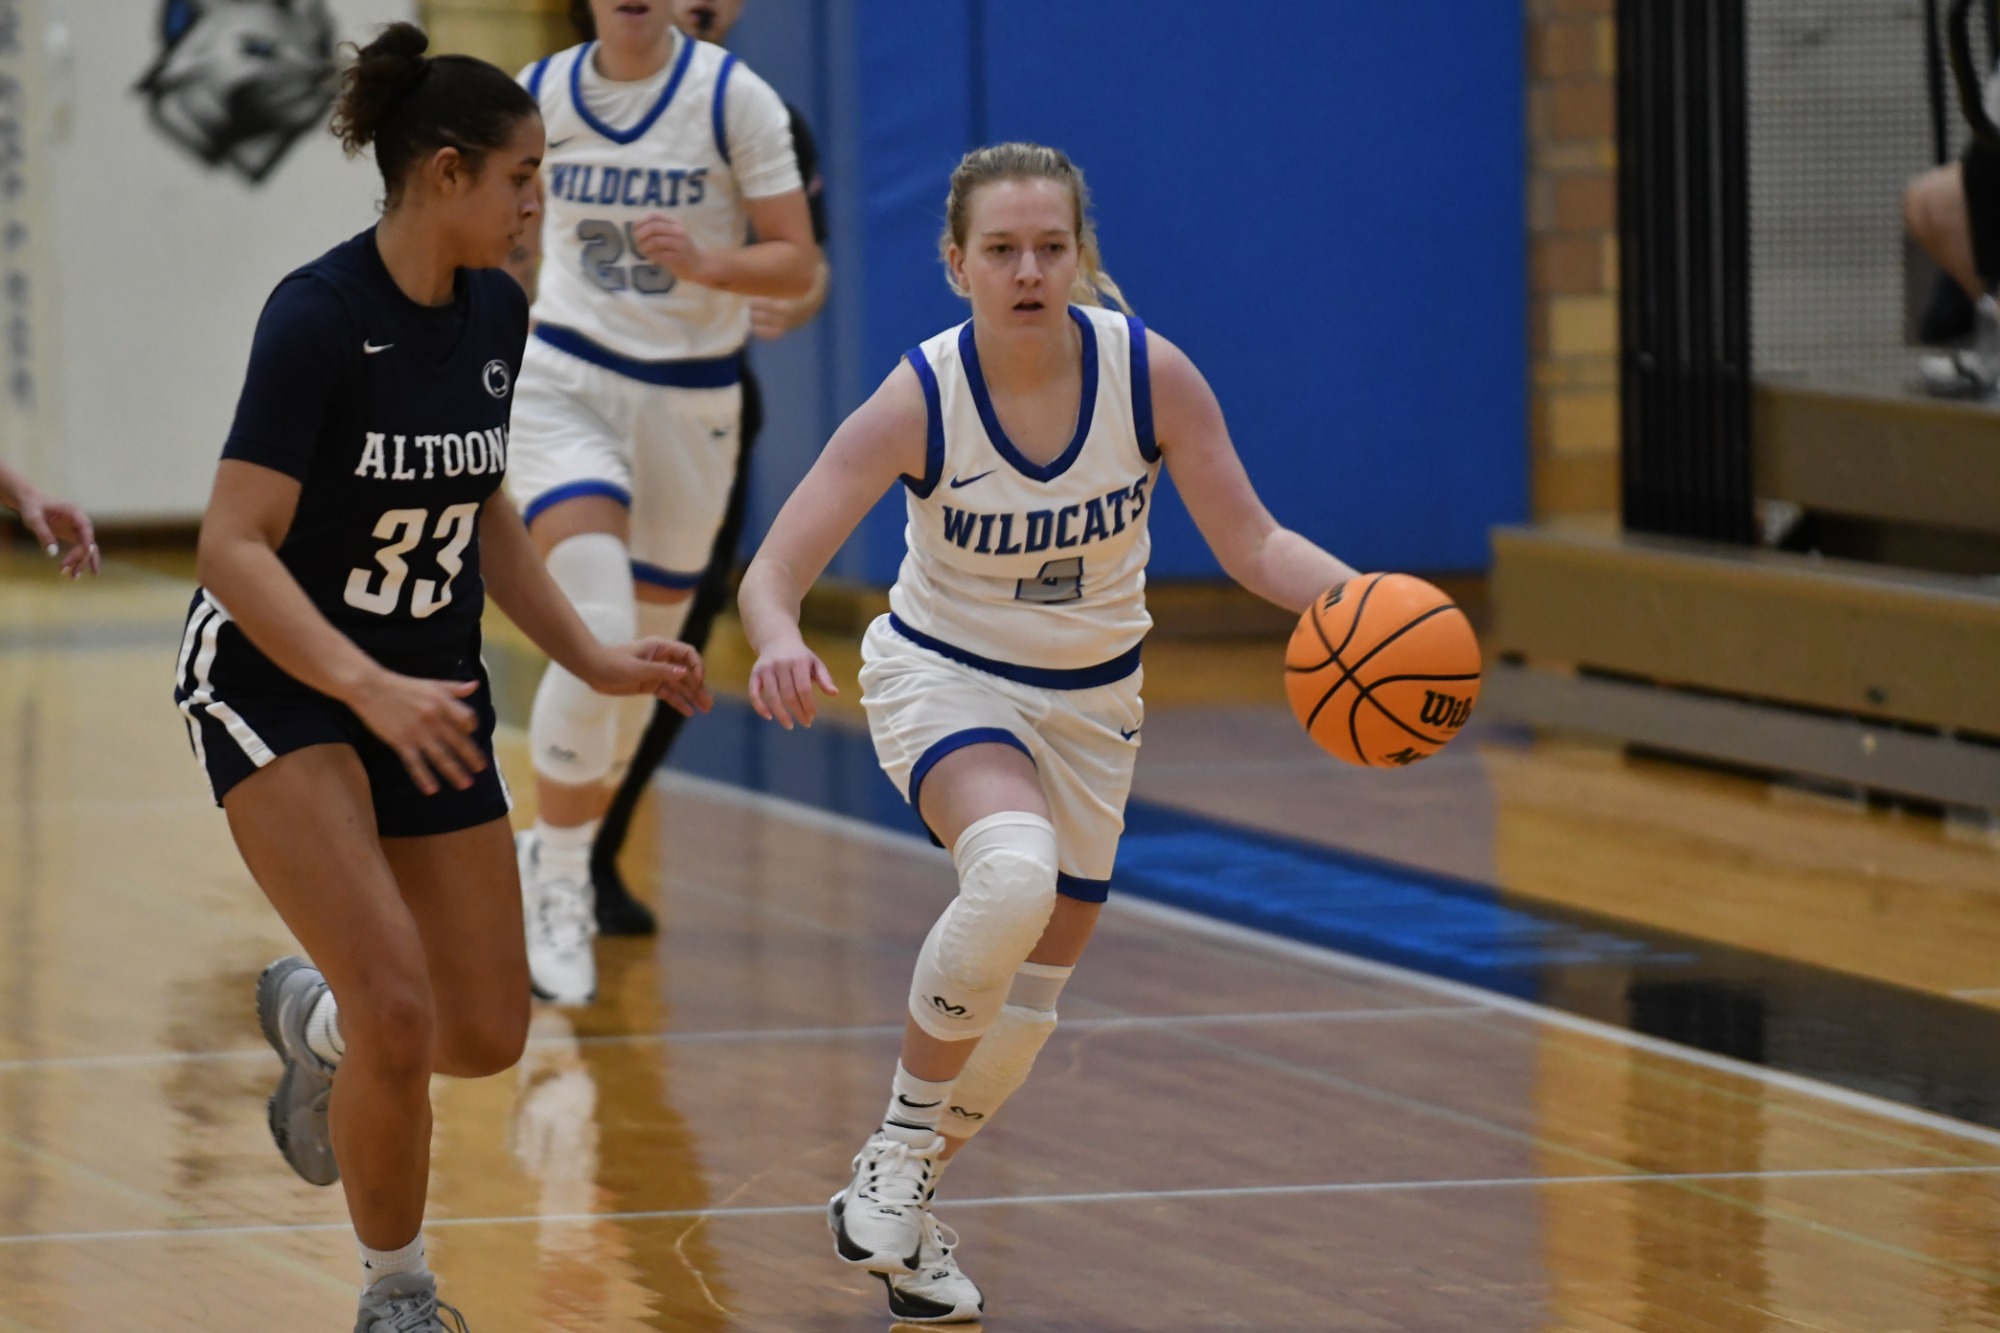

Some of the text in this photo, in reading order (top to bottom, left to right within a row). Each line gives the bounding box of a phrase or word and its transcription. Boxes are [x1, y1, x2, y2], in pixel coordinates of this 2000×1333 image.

[550, 162, 708, 207] WILDCATS
[354, 423, 509, 481] ALTOON
[942, 473, 1149, 556] WILDCATS
[343, 502, 480, 619] 33
